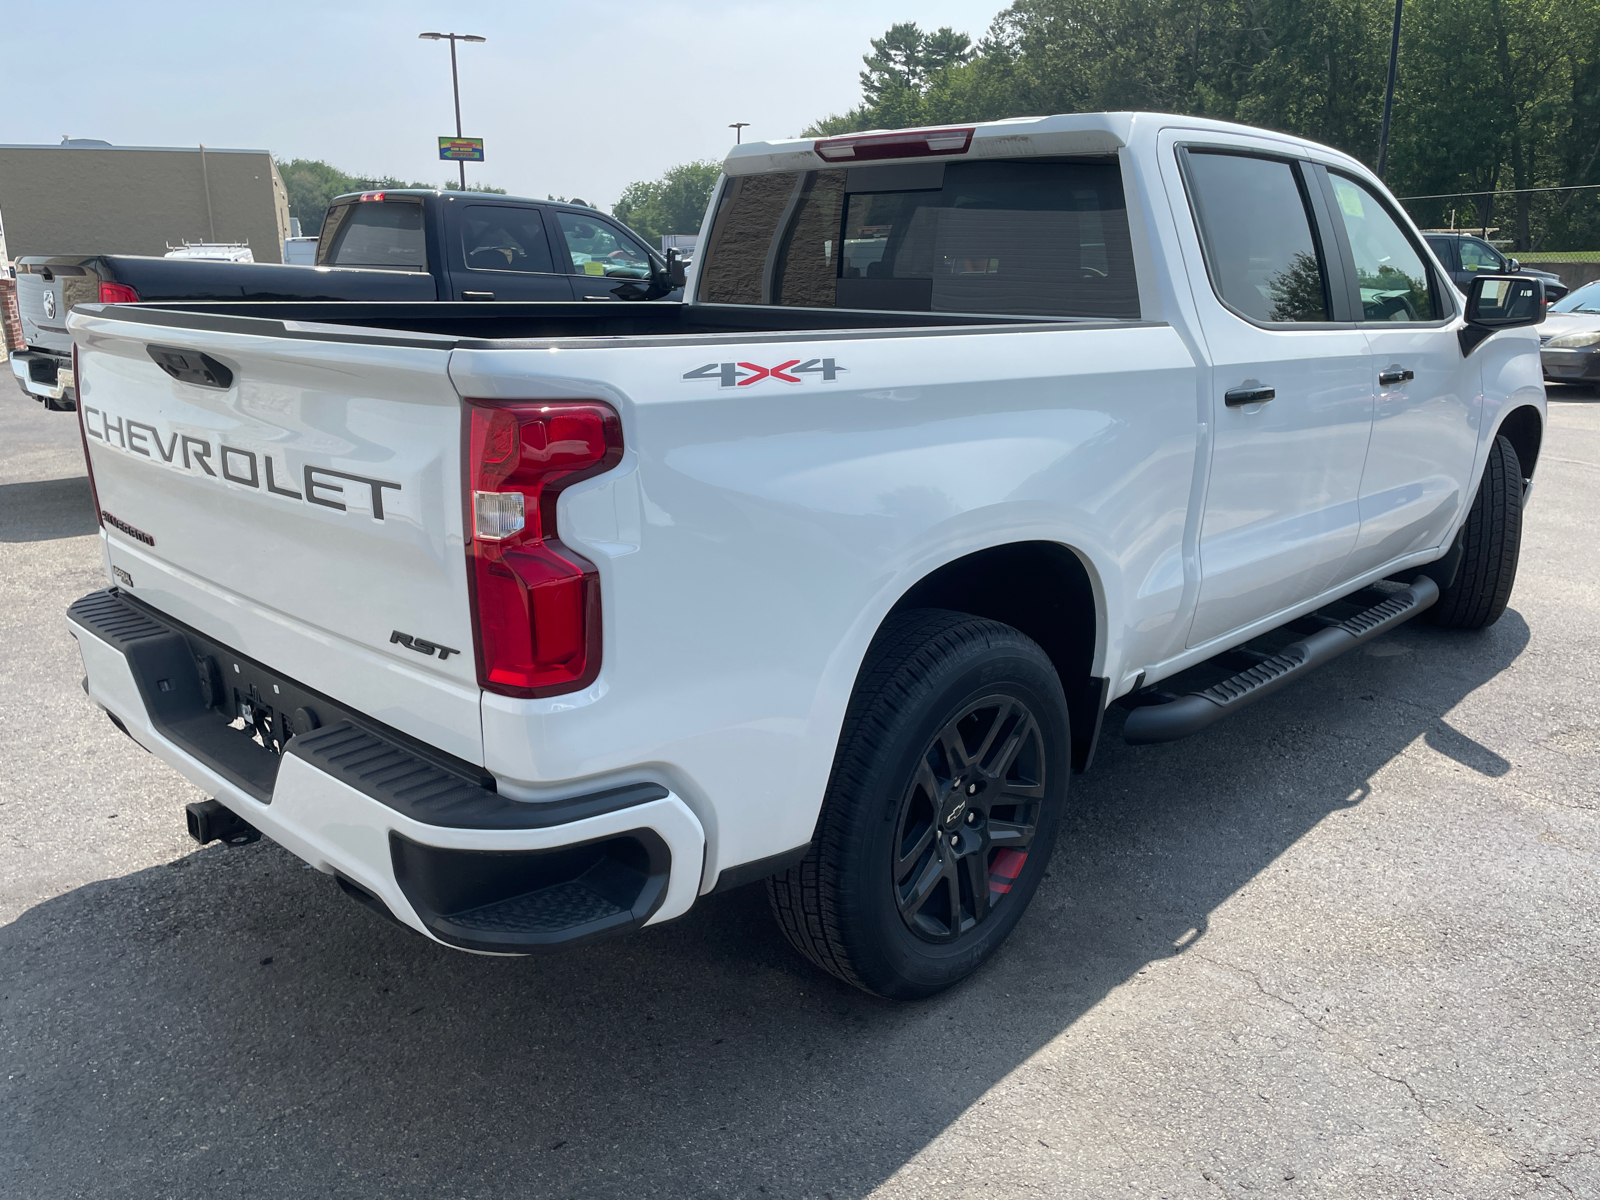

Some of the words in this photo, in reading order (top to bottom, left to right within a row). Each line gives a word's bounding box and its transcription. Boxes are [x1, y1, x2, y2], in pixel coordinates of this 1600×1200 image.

[682, 358, 848, 387] 4X4
[84, 405, 401, 521] CHEVROLET
[389, 630, 461, 660] RST
